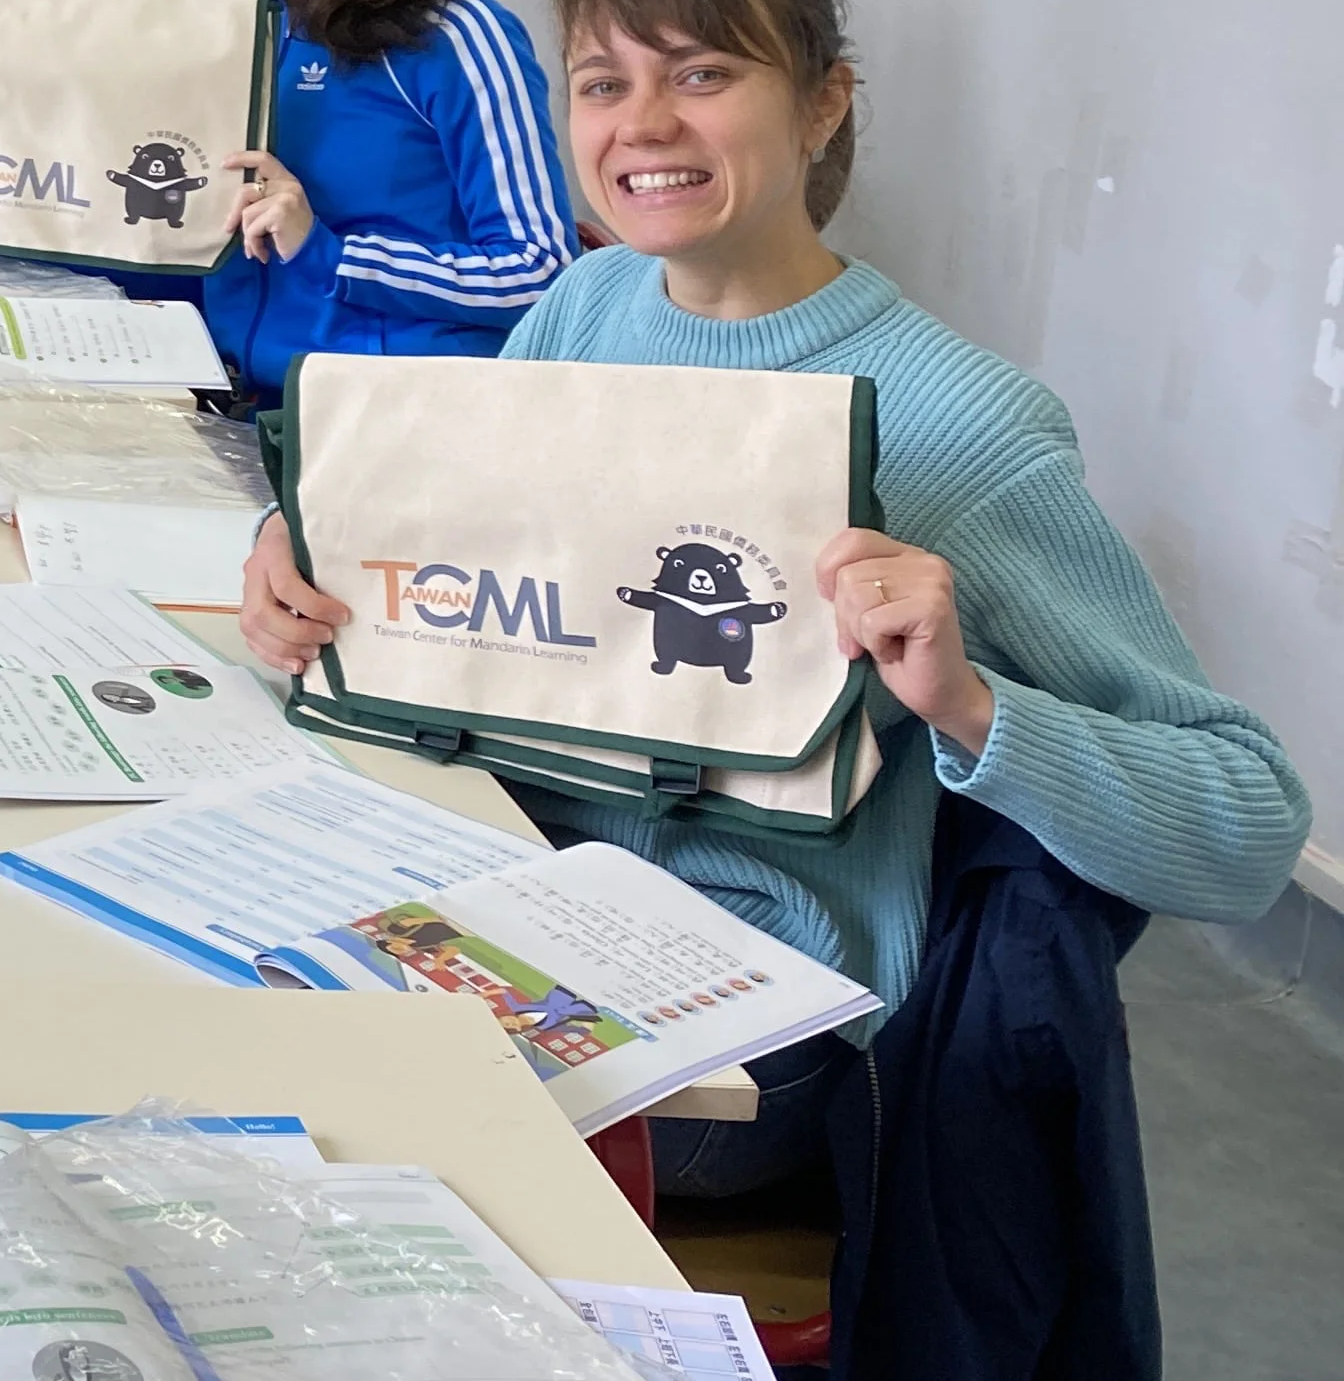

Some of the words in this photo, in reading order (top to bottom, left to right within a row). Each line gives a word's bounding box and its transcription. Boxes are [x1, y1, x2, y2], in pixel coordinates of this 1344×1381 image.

[360, 560, 597, 648] TCML
[374, 624, 411, 638] Taiwan
[413, 630, 448, 645] Center
[450, 634, 468, 647] for
[470, 637, 531, 656] Mandarin
[533, 646, 587, 664] Learning
